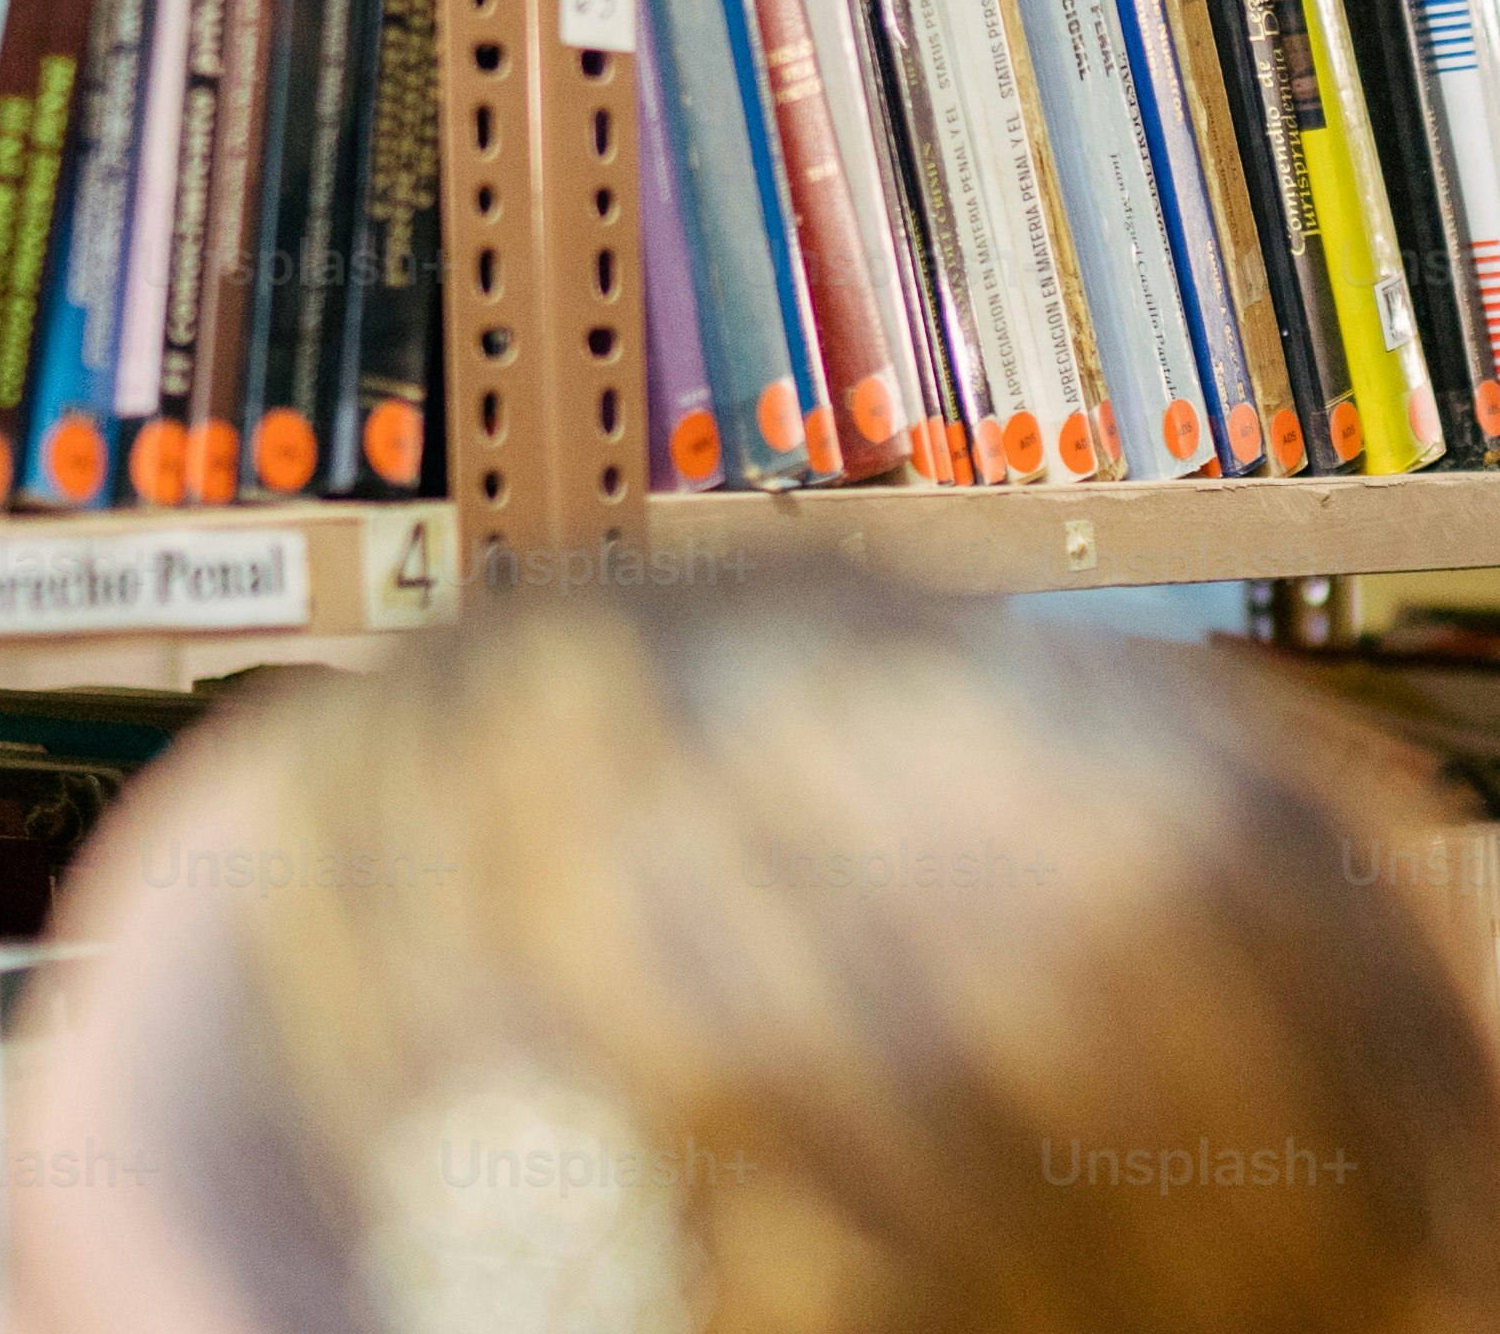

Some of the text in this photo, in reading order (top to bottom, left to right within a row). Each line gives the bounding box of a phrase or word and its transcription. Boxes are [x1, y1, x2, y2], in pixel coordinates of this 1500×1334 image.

[926, 32, 952, 90] STATUS
[1089, 3, 1116, 78] PENAL
[989, 41, 1015, 100] STATUS
[1254, 59, 1275, 88] de
[943, 103, 958, 124] EL
[948, 126, 961, 137] Y
[1004, 111, 1021, 133] EL
[1010, 136, 1024, 149] Y
[1261, 46, 1322, 237] Jurisprudencia
[952, 142, 975, 193] PENAL
[1013, 152, 1036, 202] PENAL
[1259, 104, 1310, 256] Compendio
[964, 196, 991, 264] MATERIA
[1024, 204, 1051, 273] MATERIA
[980, 266, 998, 290] EN
[1040, 275, 1057, 297] EN
[987, 292, 1022, 397] APRECIACION
[1046, 301, 1079, 403] APRECIACION
[155, 545, 287, 605] Penal
[395, 521, 436, 610] 4
